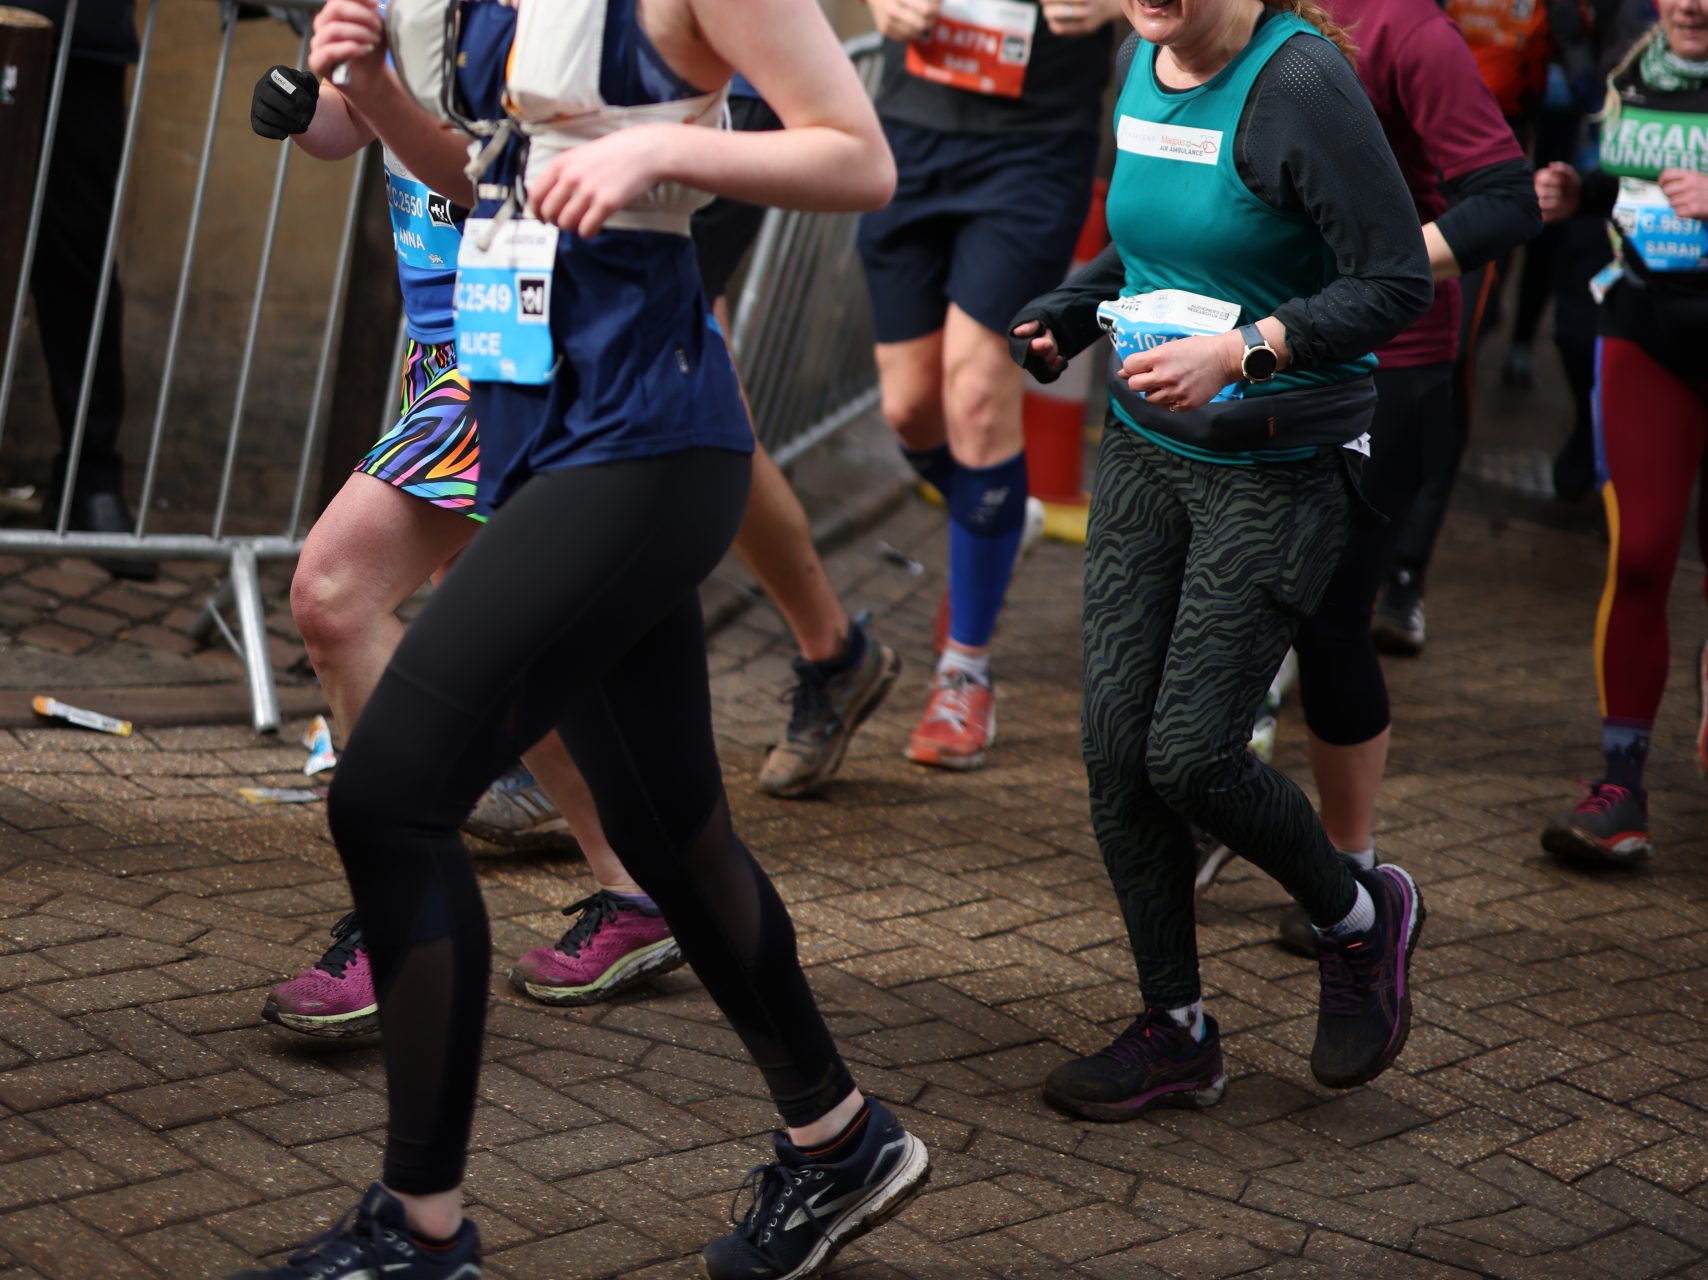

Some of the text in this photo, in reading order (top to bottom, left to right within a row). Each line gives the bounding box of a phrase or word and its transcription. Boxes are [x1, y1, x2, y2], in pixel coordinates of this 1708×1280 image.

[1169, 146, 1204, 157] AMBULANCE
[392, 187, 423, 218] C.2550
[399, 227, 425, 251] ANNA
[1645, 239, 1701, 258] SARAH
[459, 331, 502, 356] ALICE
